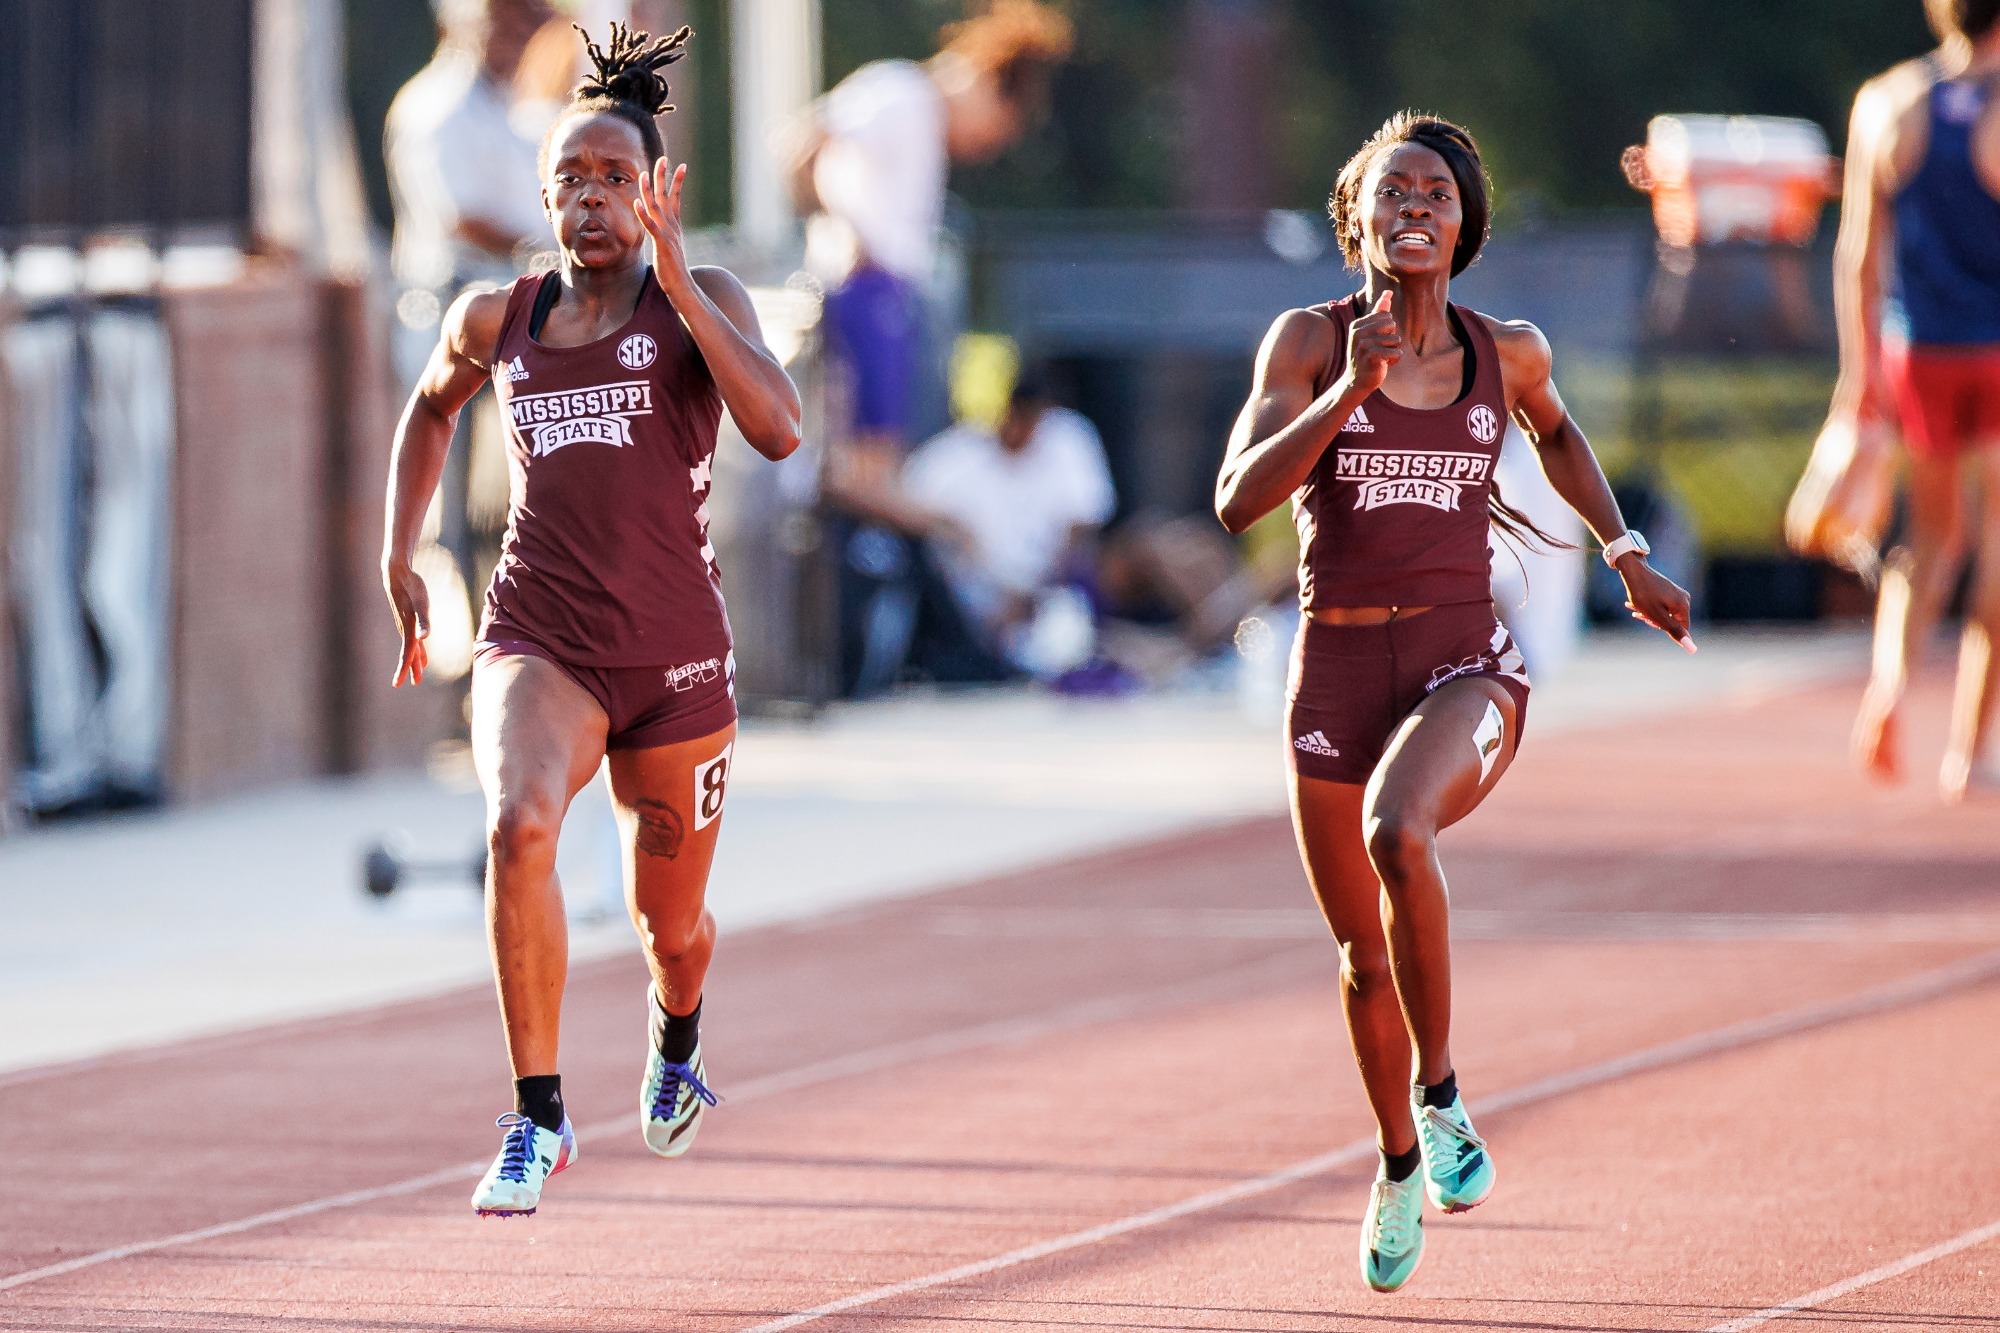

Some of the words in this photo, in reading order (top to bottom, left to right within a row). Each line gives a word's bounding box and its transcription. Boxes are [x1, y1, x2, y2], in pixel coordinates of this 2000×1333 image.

[620, 336, 654, 367] SEC
[509, 386, 653, 425] MISSISSIPPI
[546, 421, 614, 448] STATE
[1341, 421, 1375, 433] didas
[1469, 407, 1496, 442] SEC
[1335, 454, 1491, 481] MISSISSIPPI
[1374, 482, 1446, 505] STATE
[1294, 740, 1340, 757] adidas
[701, 757, 727, 819] 8
